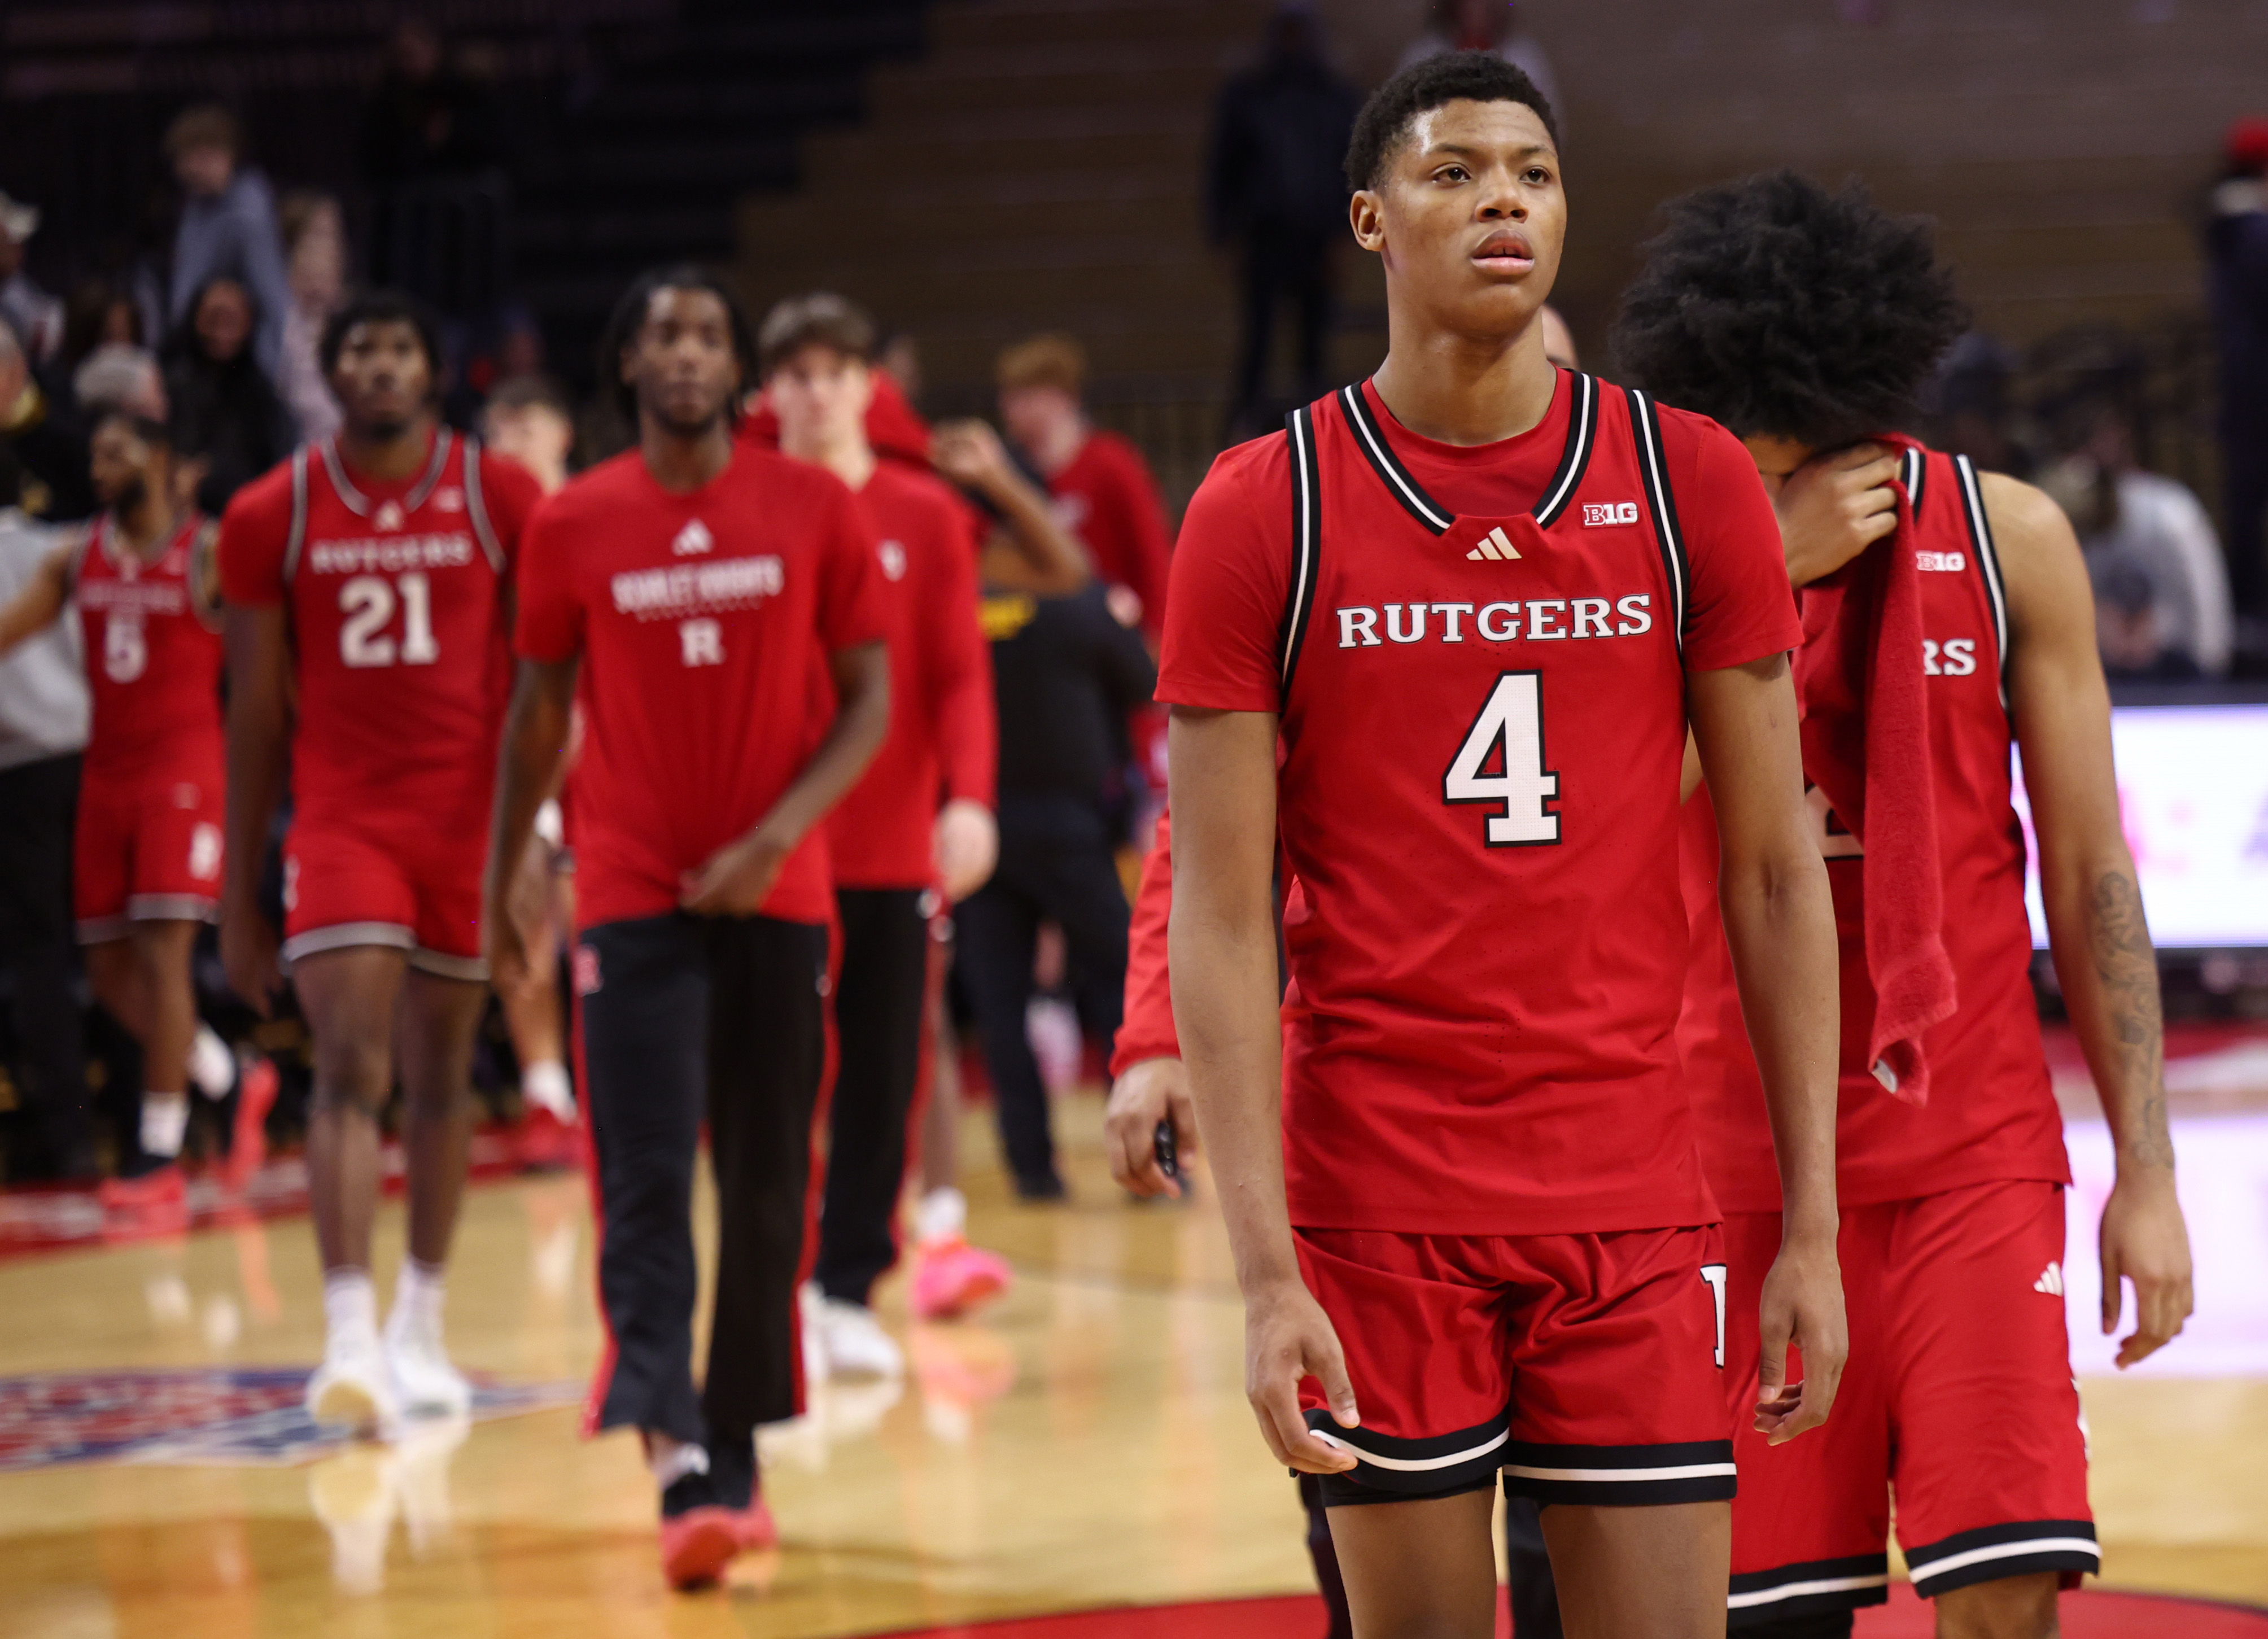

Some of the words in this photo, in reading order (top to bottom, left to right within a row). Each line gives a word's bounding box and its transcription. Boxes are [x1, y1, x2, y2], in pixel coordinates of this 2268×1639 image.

[338, 571, 440, 668] 21
[1336, 594, 1652, 649] RUTGERS
[1441, 669, 1562, 847] 4
